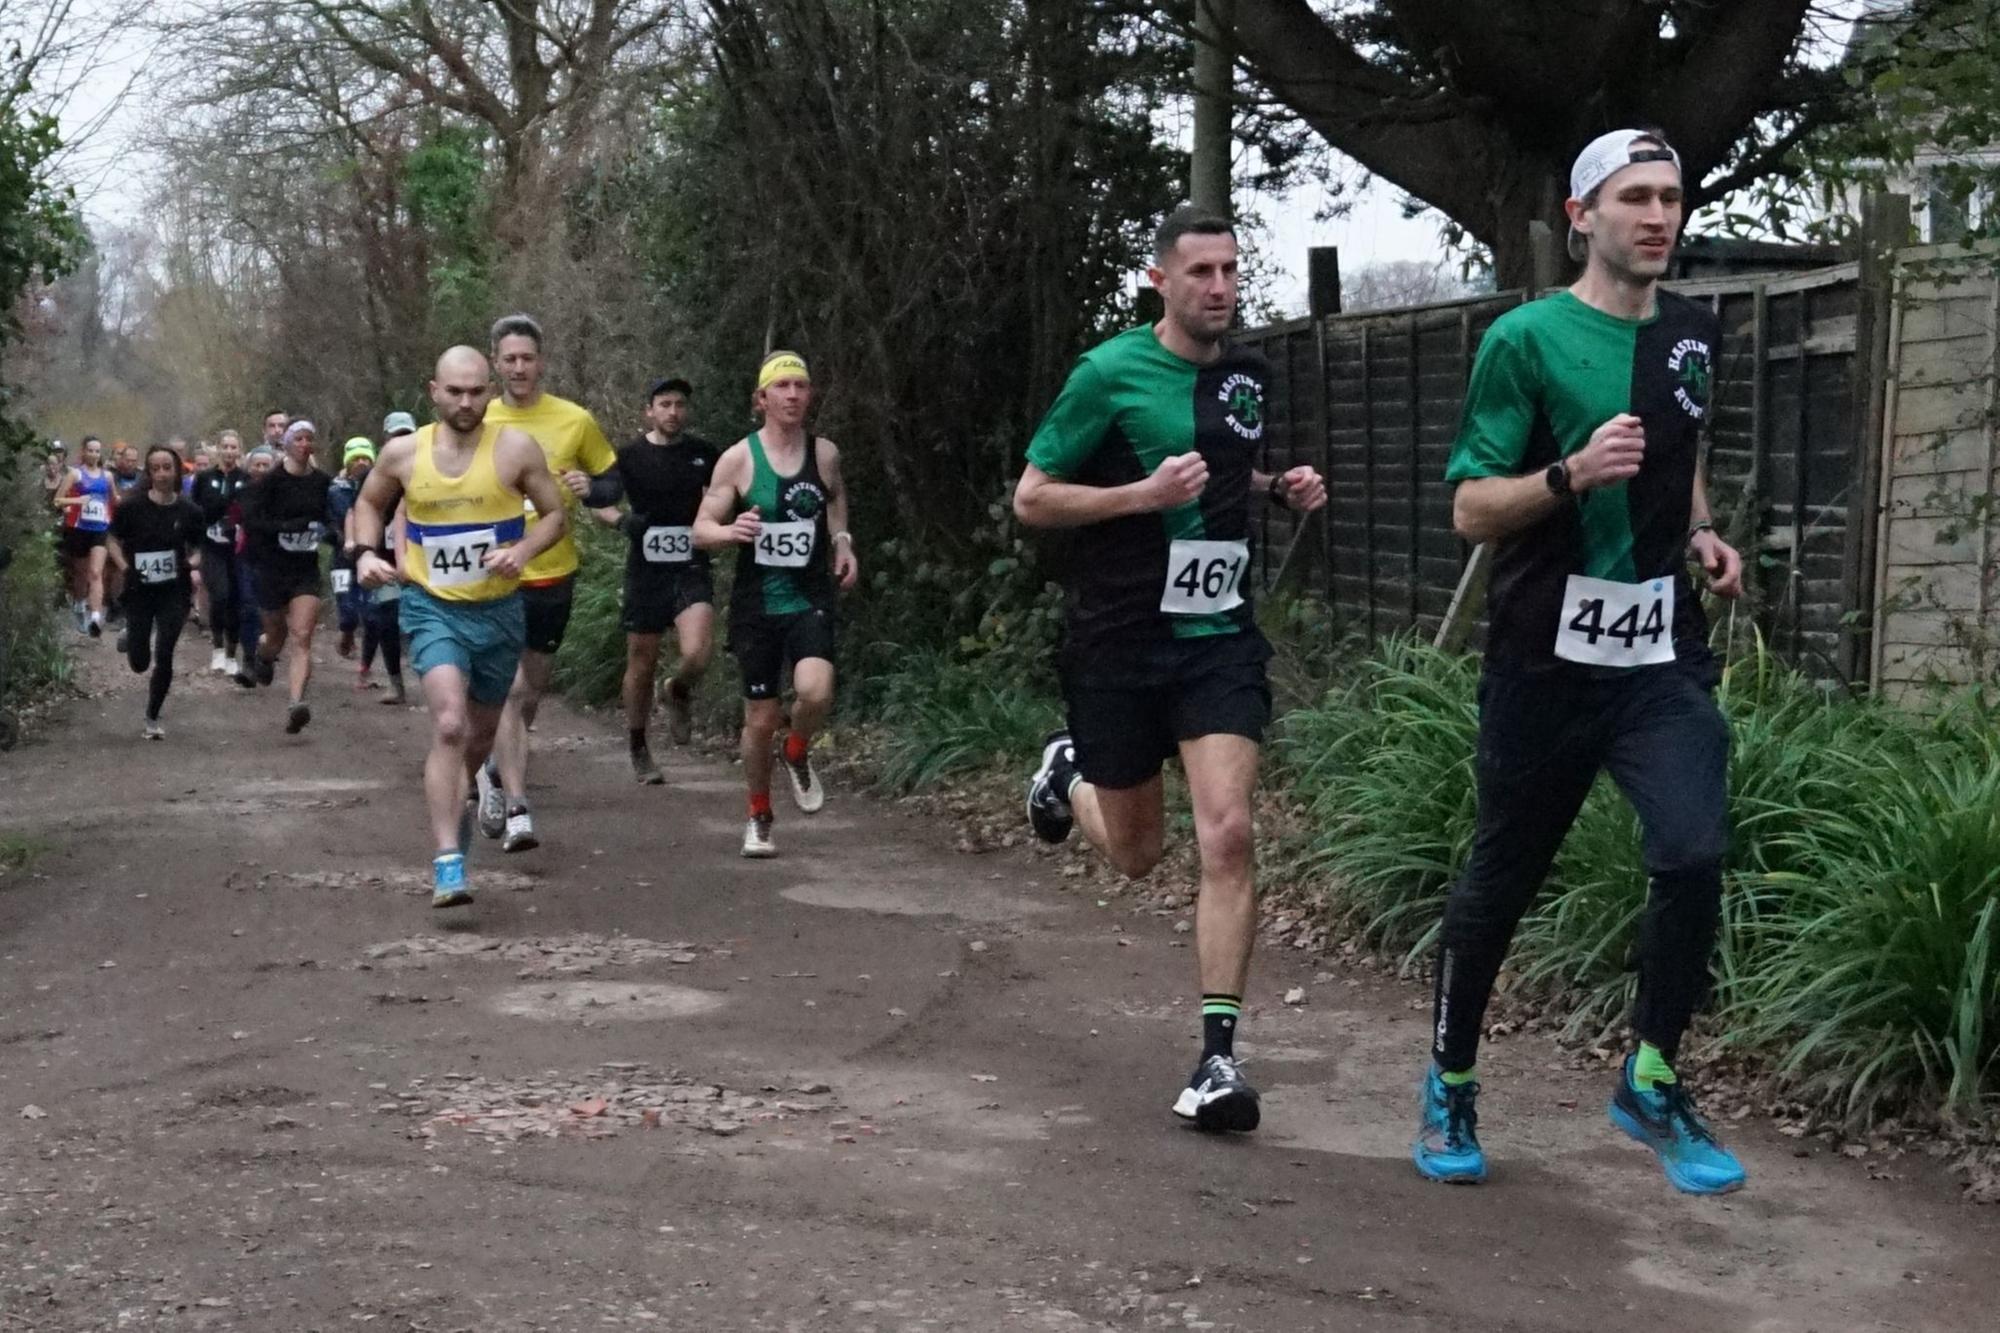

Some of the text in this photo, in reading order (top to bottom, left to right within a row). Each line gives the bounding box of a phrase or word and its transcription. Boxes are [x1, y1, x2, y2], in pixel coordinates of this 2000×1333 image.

[432, 542, 490, 574] 447
[647, 534, 690, 554] 433
[759, 532, 811, 557] 453
[139, 557, 174, 579] 445
[1173, 556, 1241, 598] 461
[1568, 598, 1665, 648] 444
